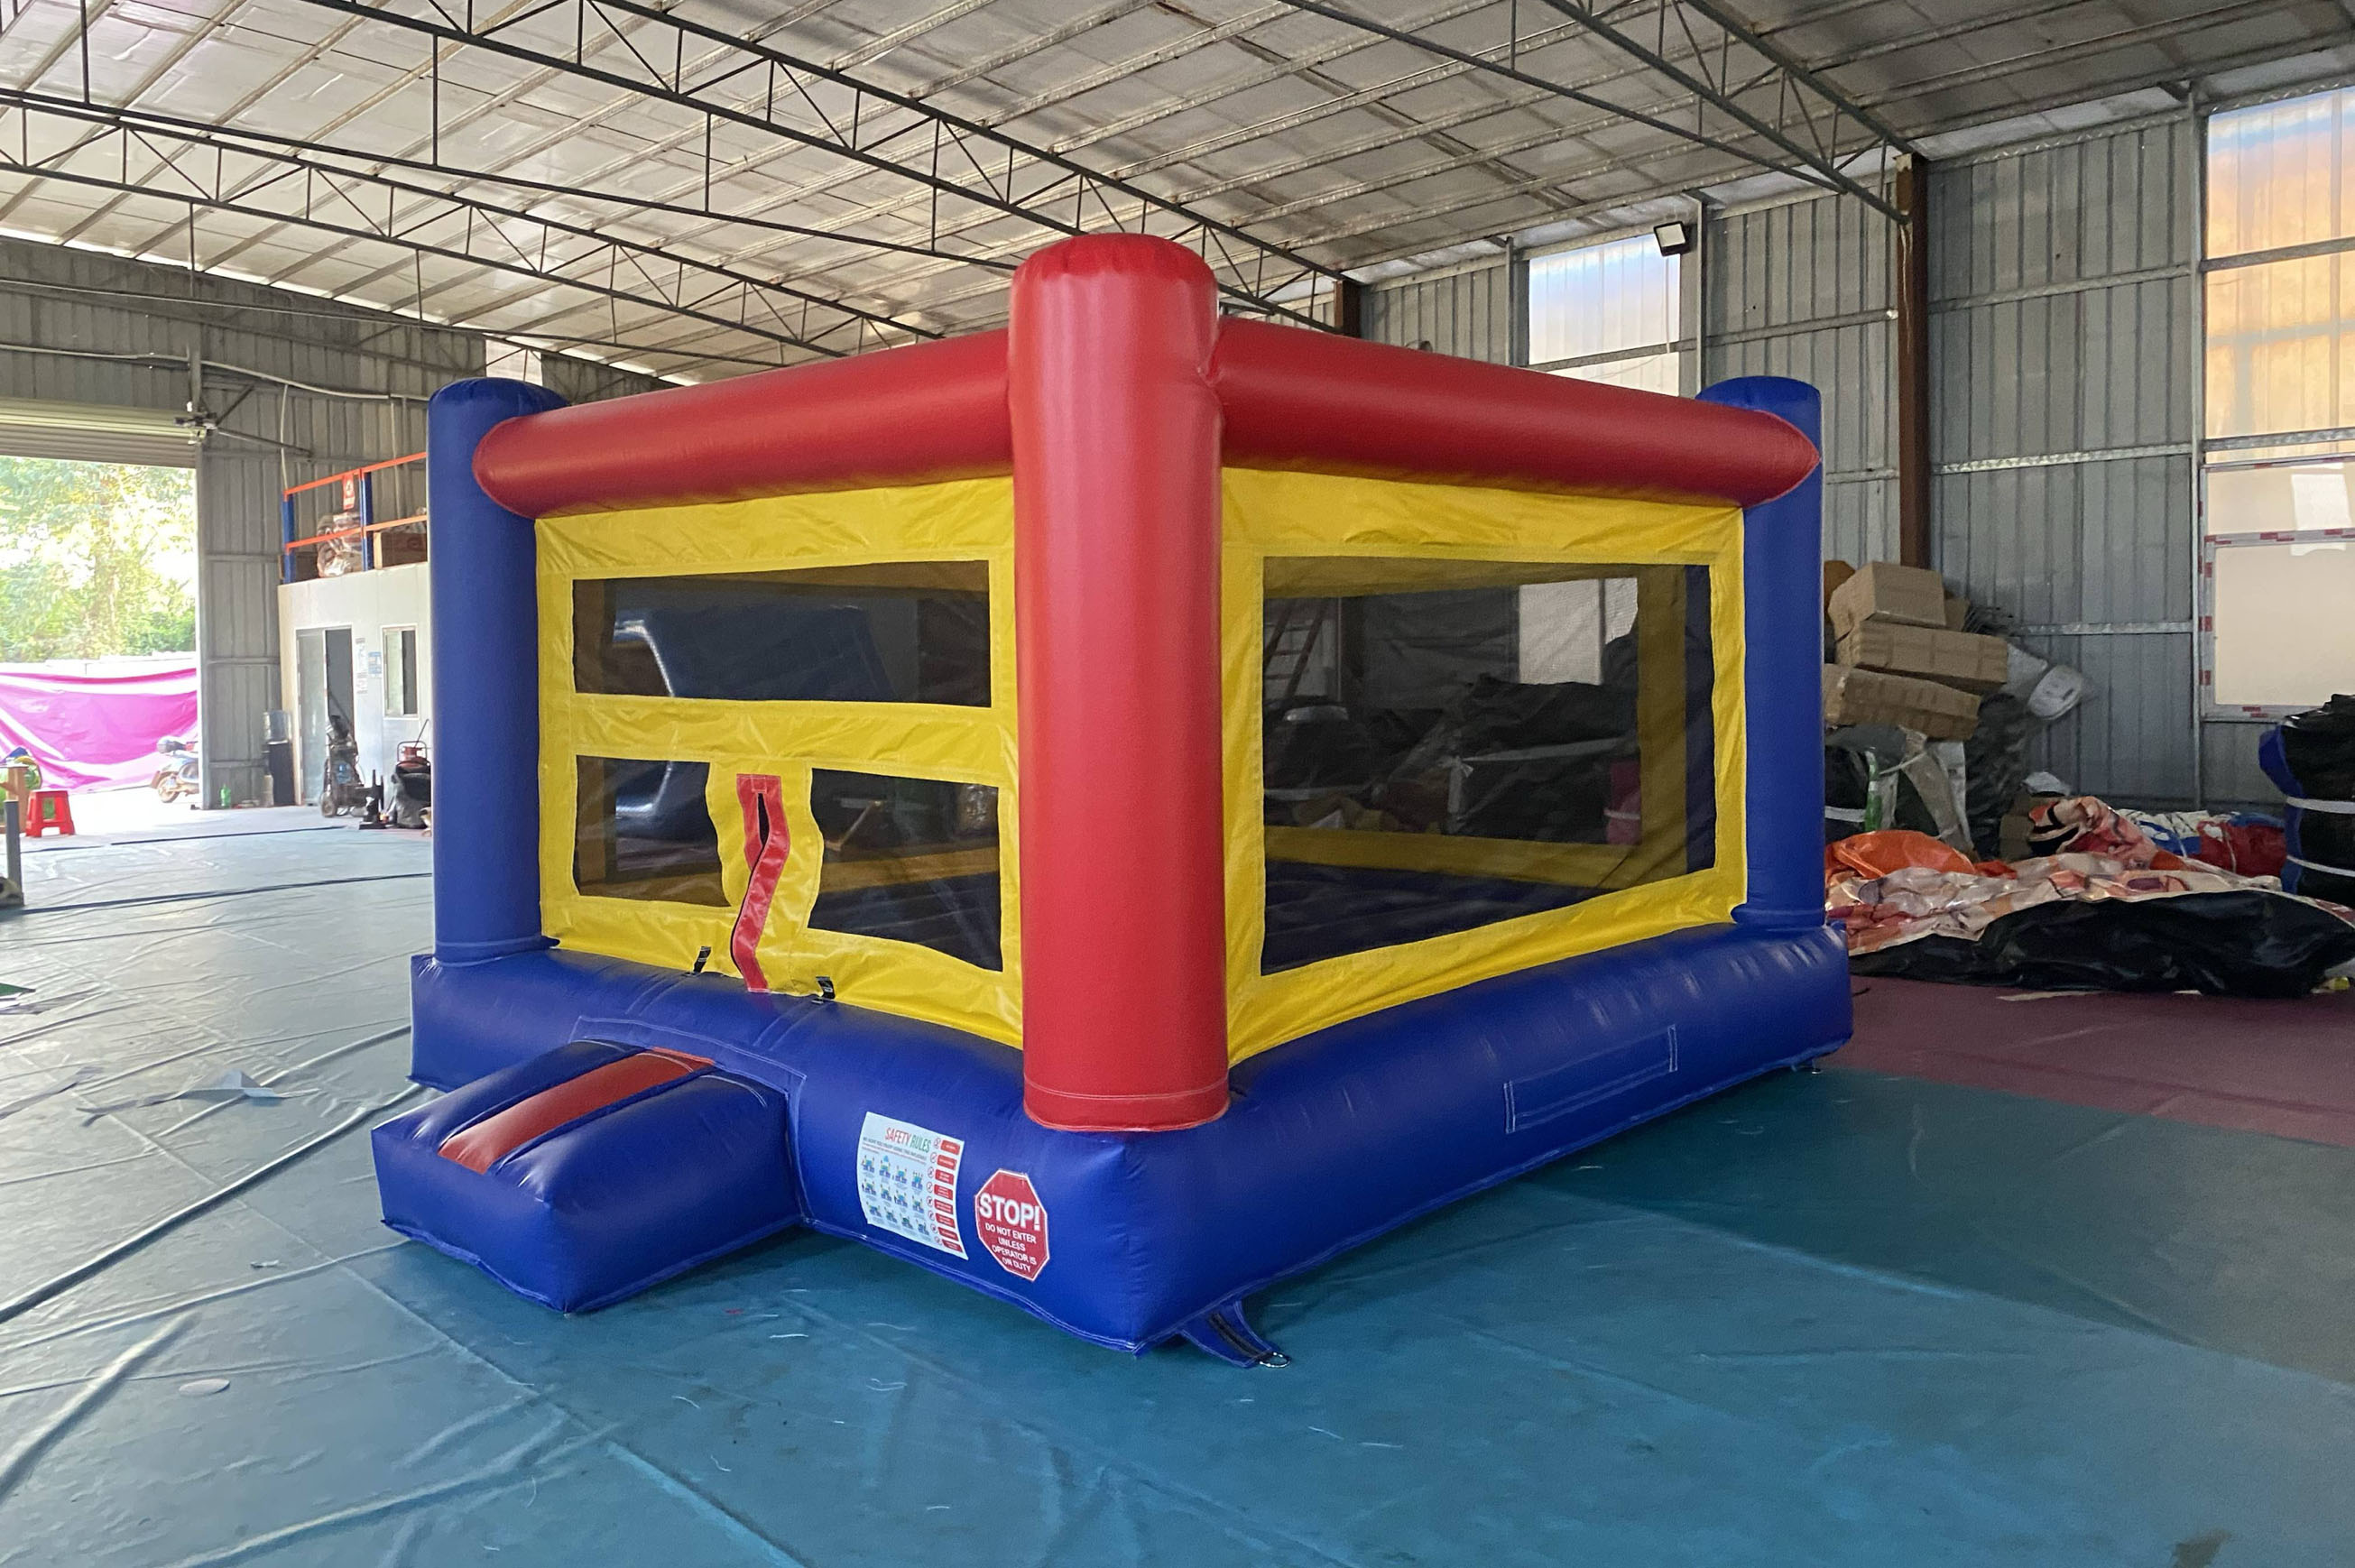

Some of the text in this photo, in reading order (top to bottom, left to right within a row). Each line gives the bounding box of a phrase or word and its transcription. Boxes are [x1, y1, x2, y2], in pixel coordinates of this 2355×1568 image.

[885, 1127, 912, 1146] SAFETY
[910, 1134, 931, 1153] RULES
[980, 1193, 1040, 1231] STOP!
[985, 1222, 1037, 1244] DO NOT ENTER
[998, 1237, 1026, 1252] UNLESS
[992, 1245, 1037, 1266] OPERATOR IS
[1002, 1257, 1031, 1272] ON DUTY
